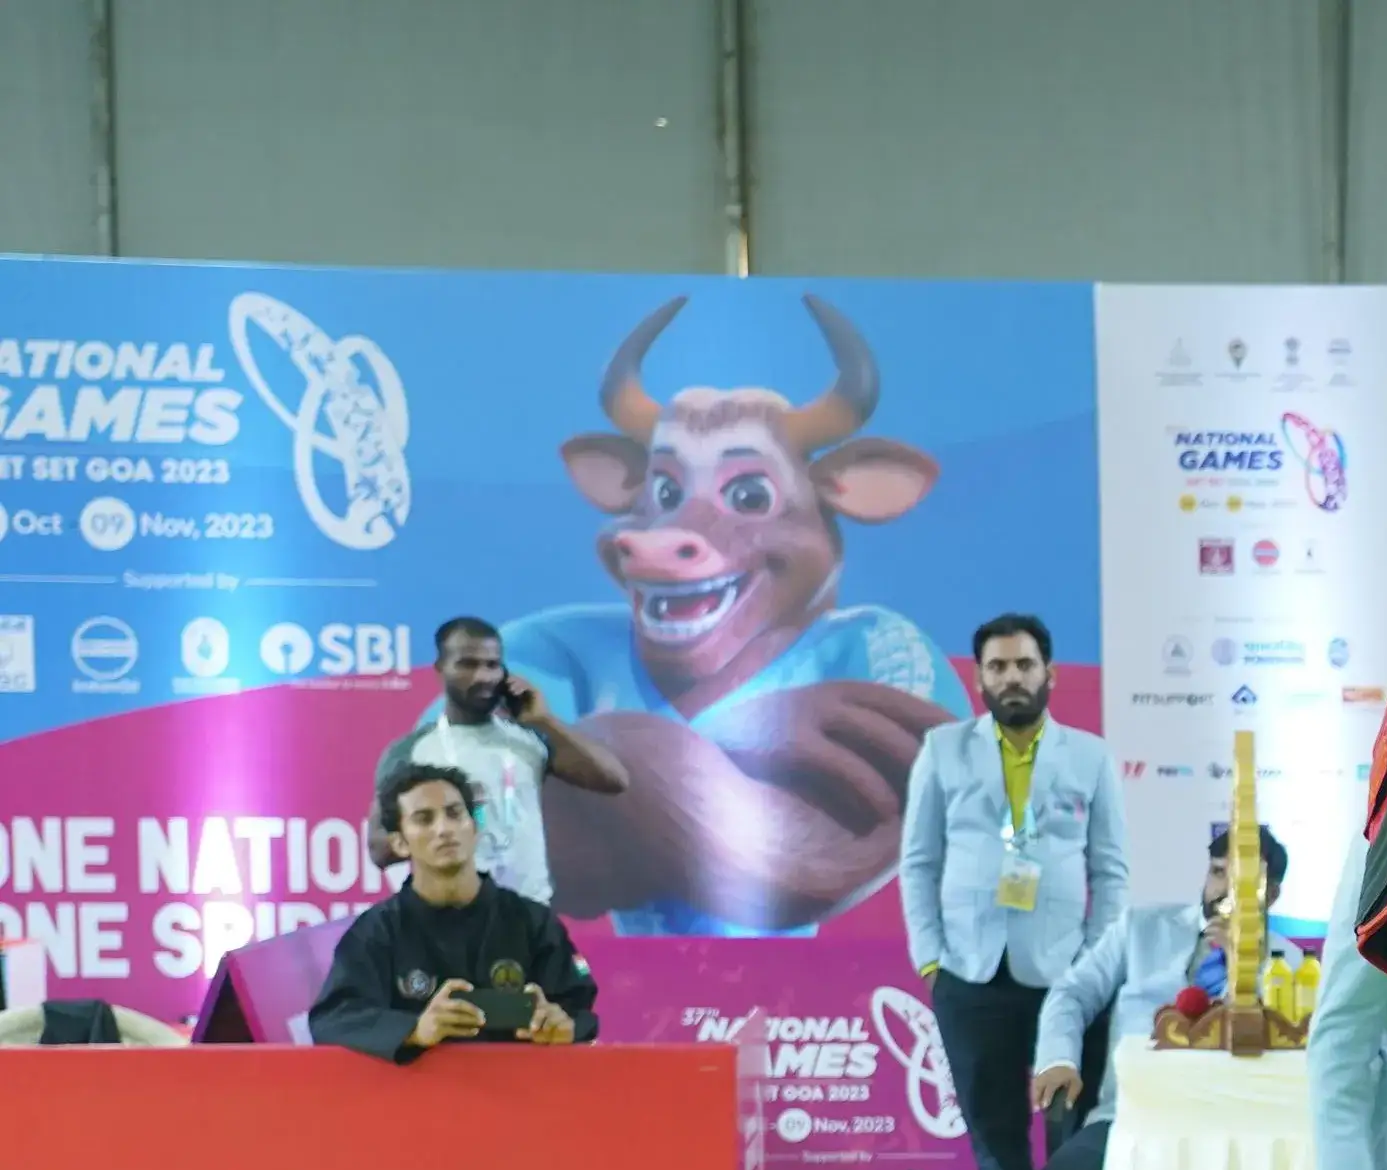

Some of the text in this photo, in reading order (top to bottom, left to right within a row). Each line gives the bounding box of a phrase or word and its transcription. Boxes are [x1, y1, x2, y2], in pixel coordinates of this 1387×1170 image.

[0, 384, 243, 445] AMES
[1174, 432, 1277, 447] NATIONAL
[32, 455, 79, 481] SET
[86, 457, 154, 482] GOA
[161, 458, 230, 483] 2023
[1178, 449, 1284, 471] GAMES
[13, 509, 63, 535] Oct
[139, 512, 199, 540] Nov,
[204, 512, 274, 539] 2023
[318, 623, 411, 676] SBI
[0, 816, 116, 893] NE
[0, 901, 130, 979] NE
[829, 1084, 870, 1101] 2023
[852, 1116, 895, 1133] 2023
